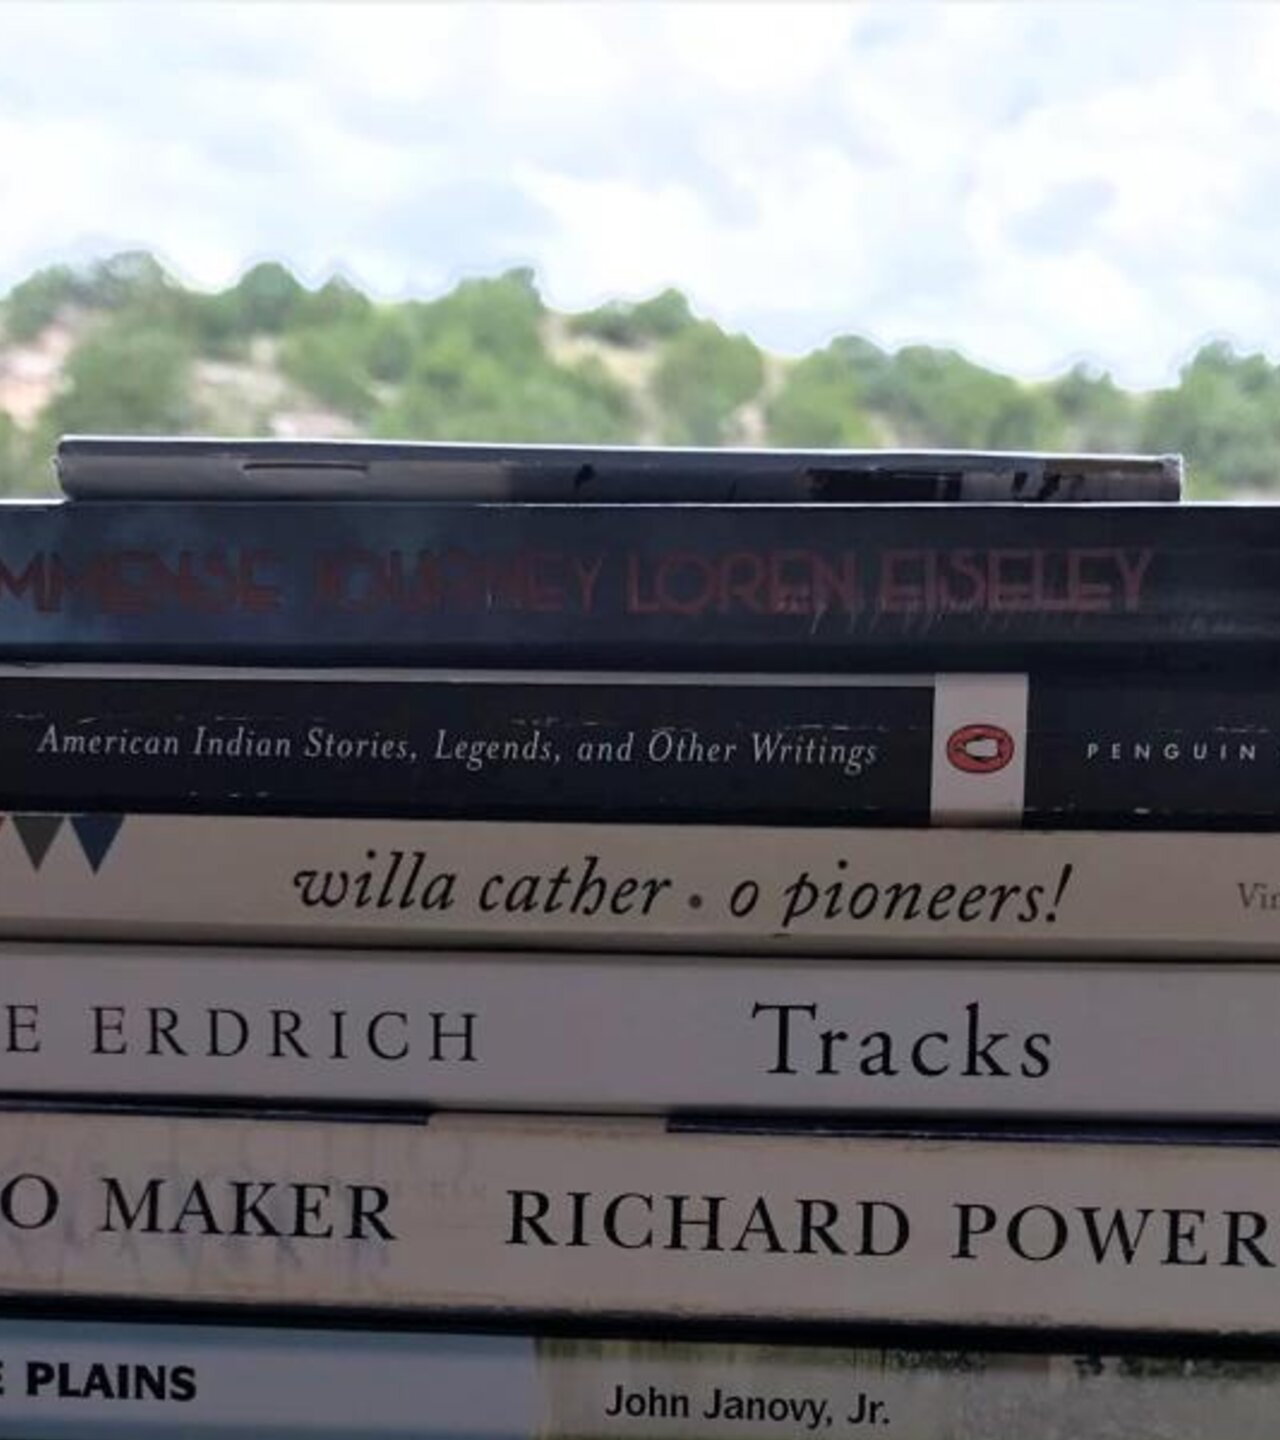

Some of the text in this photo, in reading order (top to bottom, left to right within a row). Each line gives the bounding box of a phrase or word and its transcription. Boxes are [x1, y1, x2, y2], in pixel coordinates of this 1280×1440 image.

[627, 549, 856, 616] LOREN
[880, 547, 1157, 614] EISELEY
[38, 723, 878, 775] American Indian Stories, Legends, and Other Writings
[1087, 743, 1257, 761] PENGUIN
[293, 850, 1073, 929] willa cather o pioneers!
[90, 1007, 478, 1062] ERDRICH
[751, 1001, 1053, 1080] Tracks
[101, 1176, 397, 1242] MAKER
[504, 1188, 911, 1260] RICHARD
[25, 1361, 197, 1402] PLAINS
[605, 1384, 890, 1429] John Janovy, Jr.
